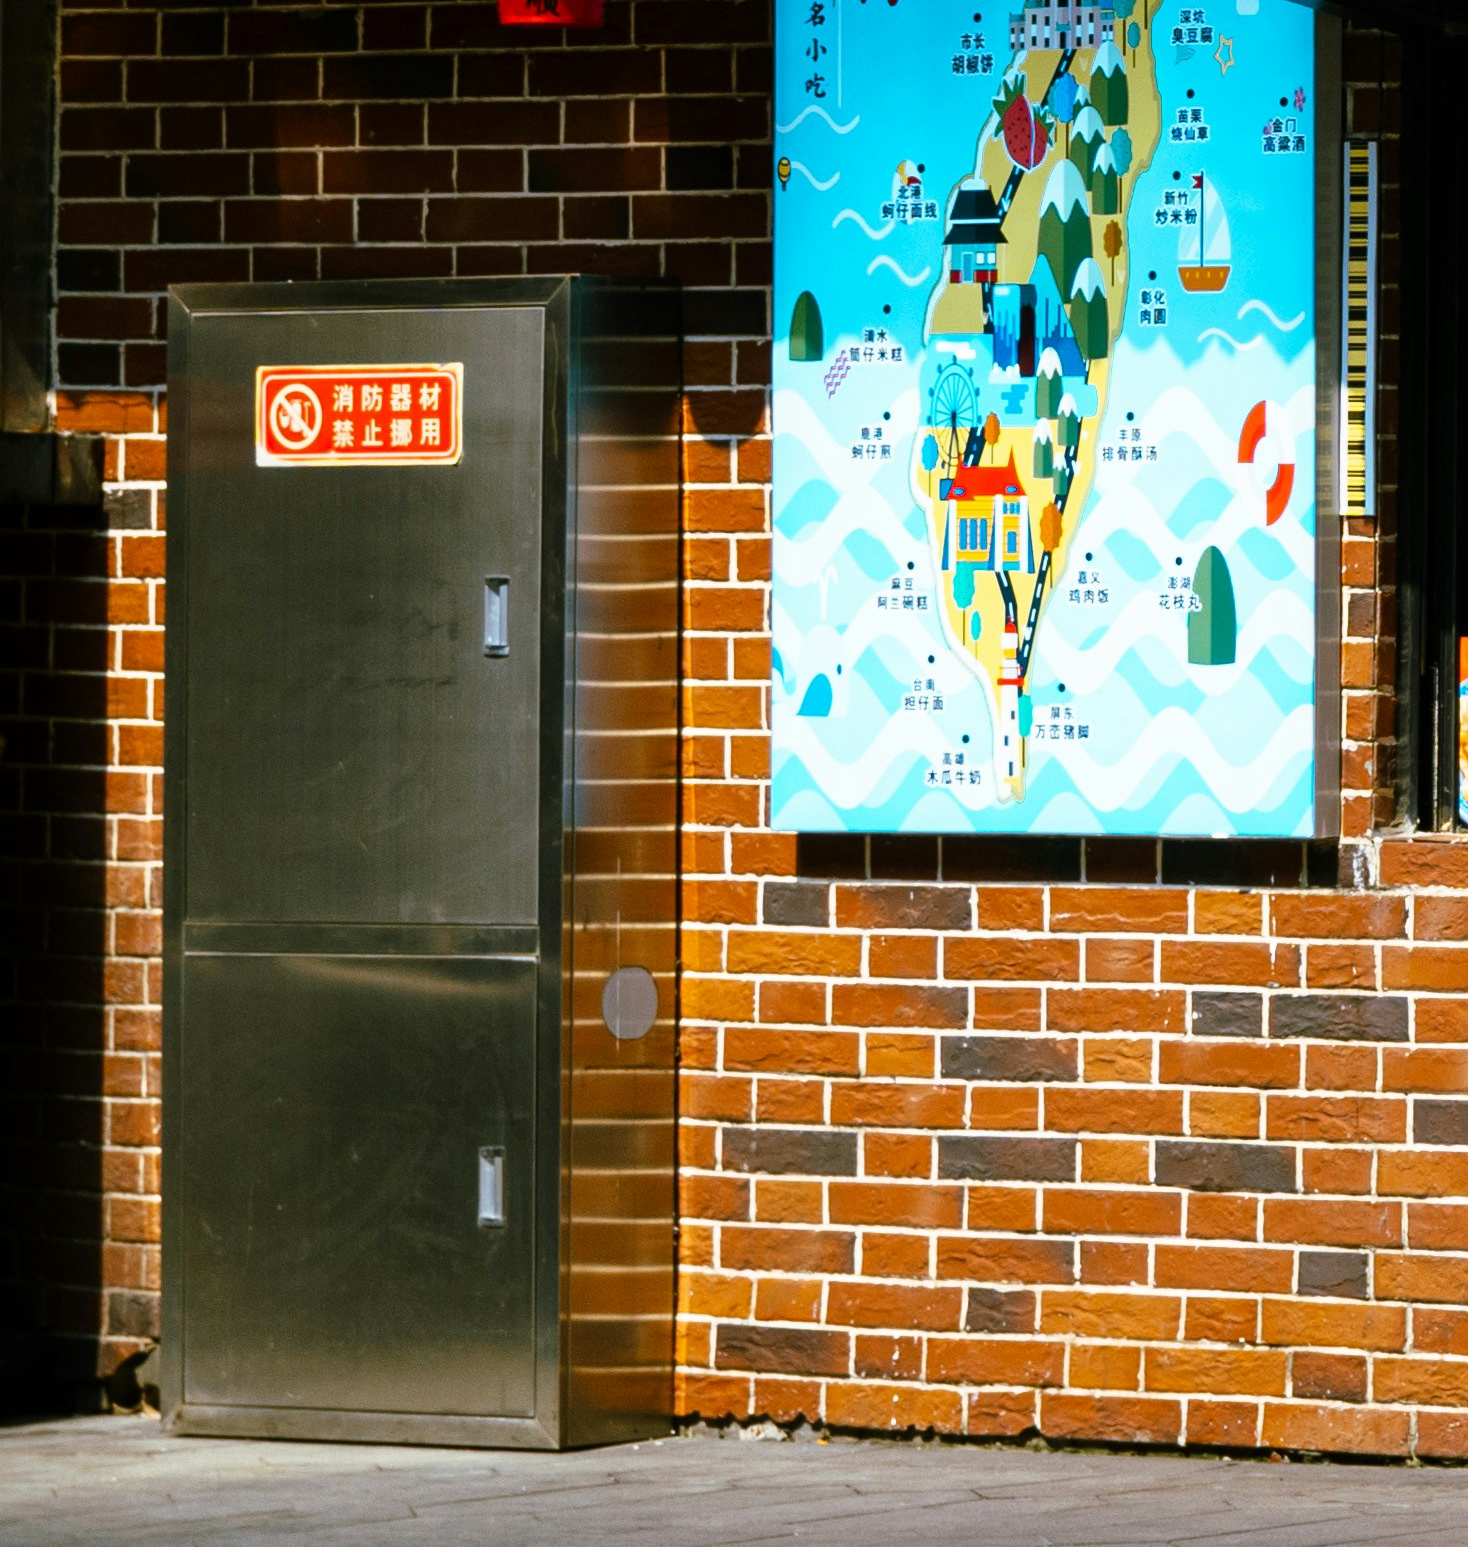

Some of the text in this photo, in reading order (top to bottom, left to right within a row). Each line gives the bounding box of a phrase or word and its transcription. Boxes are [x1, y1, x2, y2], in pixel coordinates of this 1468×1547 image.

[1180, 10, 1205, 24] 深坑
[961, 33, 985, 49] 市长
[1171, 28, 1213, 44] 臭豆腐
[952, 55, 993, 74] 胡椒饼
[1178, 109, 1202, 123] 苗栗
[1272, 119, 1296, 133] 金门
[1171, 127, 1208, 141] 烧仙草
[1165, 191, 1188, 205] 新竹
[882, 204, 937, 219] 蚵仔面线
[1156, 209, 1197, 224] 炒米粉
[1141, 291, 1165, 305] 彰化
[864, 329, 888, 342] 清水
[332, 382, 441, 413] 消防器材
[332, 418, 441, 448] 禁止挪用
[1119, 429, 1141, 441] 丰原
[1102, 446, 1157, 461] 排骨酥汤
[1078, 571, 1100, 584] 嘉义
[1167, 576, 1191, 589] 澎湖
[1069, 589, 1109, 603] 鸡肉饭
[1159, 594, 1200, 609] 花枝丸
[914, 678, 935, 691] 台南
[905, 696, 943, 710] 担仔面
[943, 753, 964, 765] 高雄
[927, 770, 981, 784] 木瓜牛奶
